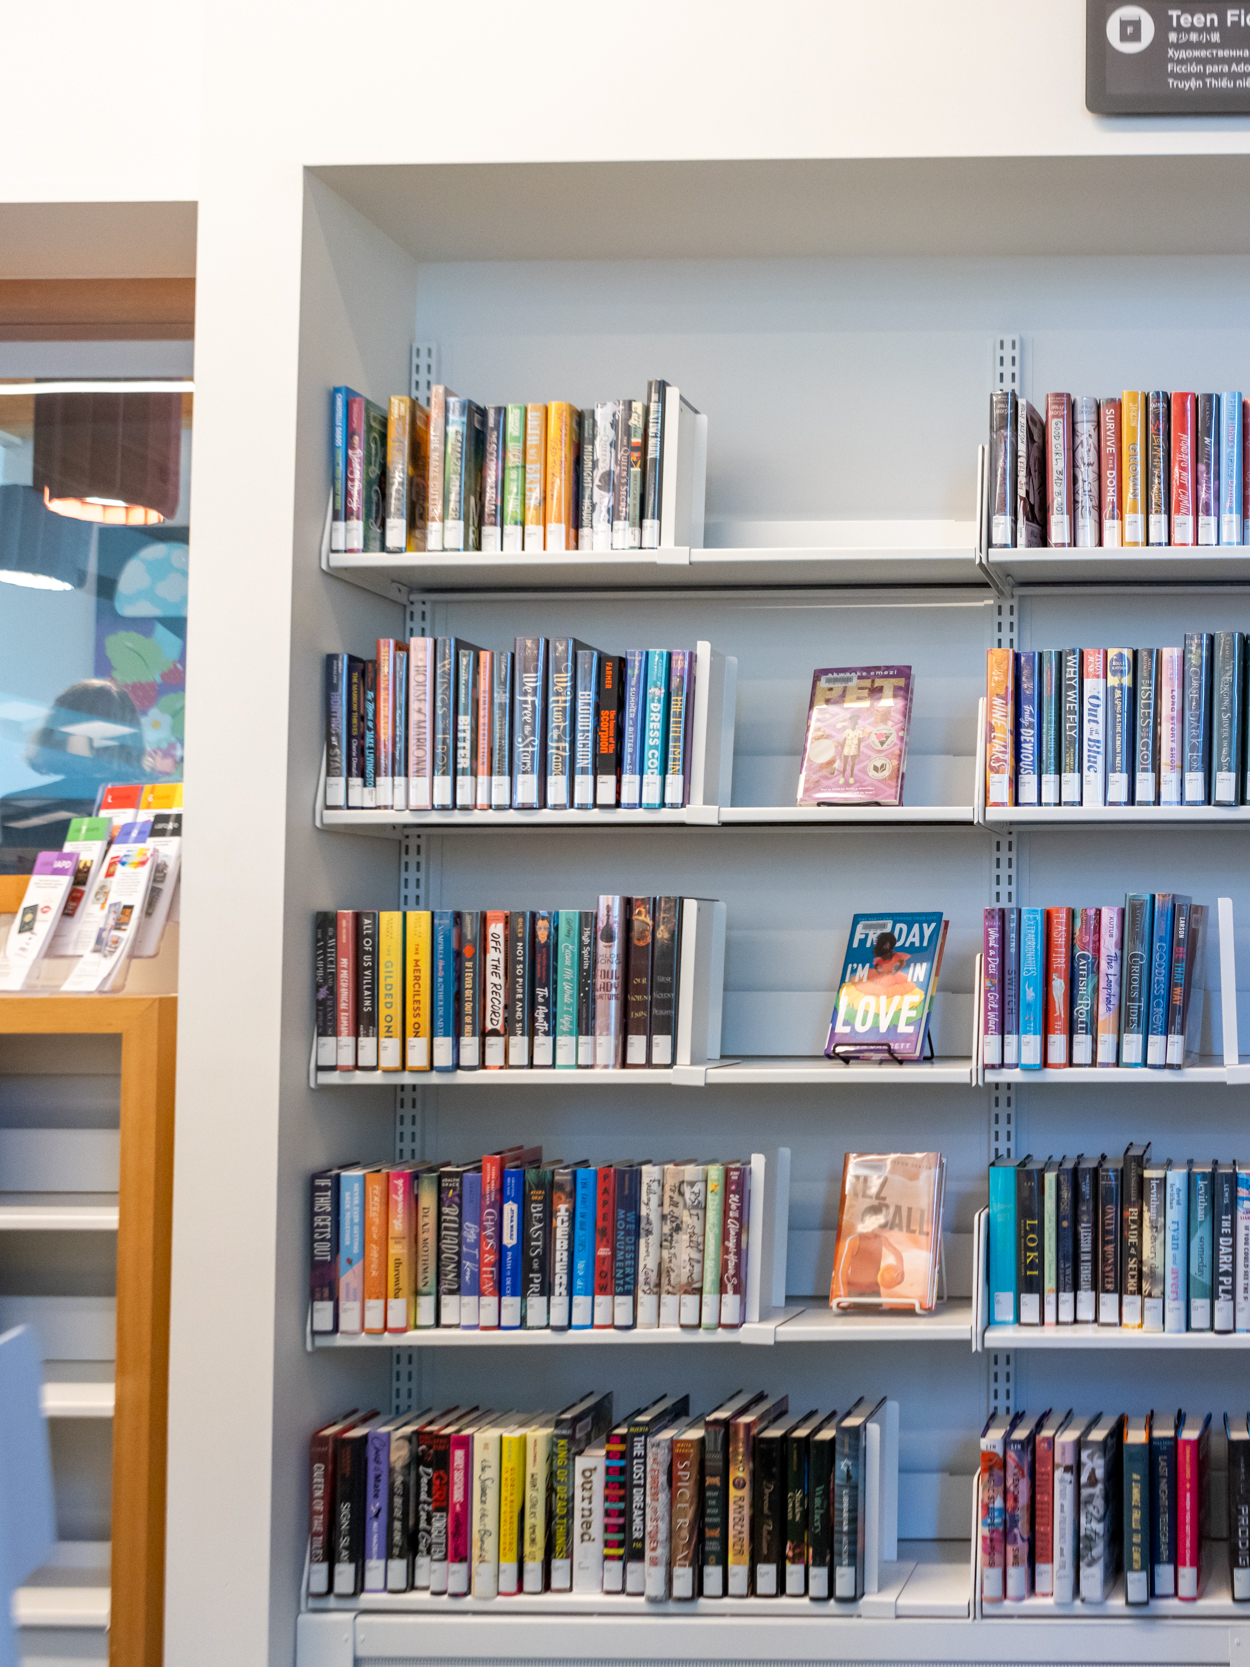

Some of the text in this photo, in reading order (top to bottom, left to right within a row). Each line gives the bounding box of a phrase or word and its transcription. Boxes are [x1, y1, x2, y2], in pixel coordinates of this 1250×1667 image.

[1168, 10, 1218, 27] Teen
[1168, 31, 1220, 44] 青少年小说
[1168, 62, 1204, 73] Ficción
[1206, 64, 1228, 75] para
[1106, 409, 1114, 453] SURVIVE
[1128, 403, 1138, 500] JACKSON GROWN
[583, 445, 592, 487] MIDNIGHT
[1178, 433, 1189, 486] MONDAY'S NOT
[517, 695, 537, 722] Free
[522, 673, 539, 692] We
[814, 678, 905, 708] PET
[1066, 654, 1077, 738] WHY WE FLY
[1140, 685, 1151, 727] ISLES
[1221, 676, 1232, 738] FORGING SILVER
[458, 715, 469, 768] BITTER
[516, 737, 538, 772] Stars
[576, 691, 591, 767] BLOOD SCION
[598, 710, 610, 753] scorpion
[991, 697, 1007, 767] NINE LIARS
[1019, 705, 1035, 775] Truly DEVIOUS
[582, 927, 590, 970] High Spirits
[852, 922, 936, 948] FRDAY
[1023, 914, 1038, 976] EXTRAORDINARIES
[1053, 913, 1066, 969] FLASH FIRE
[363, 919, 372, 1012] ALL OF US VILLAINS
[413, 959, 421, 1018] MERCILESS
[491, 932, 502, 1027] OFF THE RECORD
[845, 963, 927, 982] I'M IN
[1075, 951, 1090, 994] CATFISH
[1100, 953, 1118, 1013] The Loophole
[1126, 951, 1146, 1030] CURIOUS TIDES
[1172, 947, 1186, 1006] BE THAT WAY
[536, 987, 548, 1002] The
[834, 995, 920, 1033] LOVE
[314, 1190, 331, 1212] THIS
[314, 1215, 330, 1239] GETS
[483, 1208, 497, 1250] CHAOS
[1127, 1207, 1138, 1247] BLADE
[1149, 1180, 1159, 1260] levithan every
[314, 1242, 330, 1262] OUT
[439, 1204, 459, 1290] BELLADONNA
[529, 1203, 543, 1270] BEASTS OF
[615, 1208, 625, 1293] MONUMENTS
[624, 1211, 635, 1291] WE DESERVE
[1026, 1219, 1038, 1276] LOKI
[1194, 1181, 1207, 1279] levithan someday
[1219, 1214, 1232, 1272] THE DARK
[1170, 1220, 1181, 1302] ryan avery
[556, 1439, 567, 1559] KING OF DEAD THINGS
[581, 1466, 598, 1544] burned
[632, 1436, 644, 1539] THE LOST DREAMER
[340, 1502, 350, 1530] SIGN
